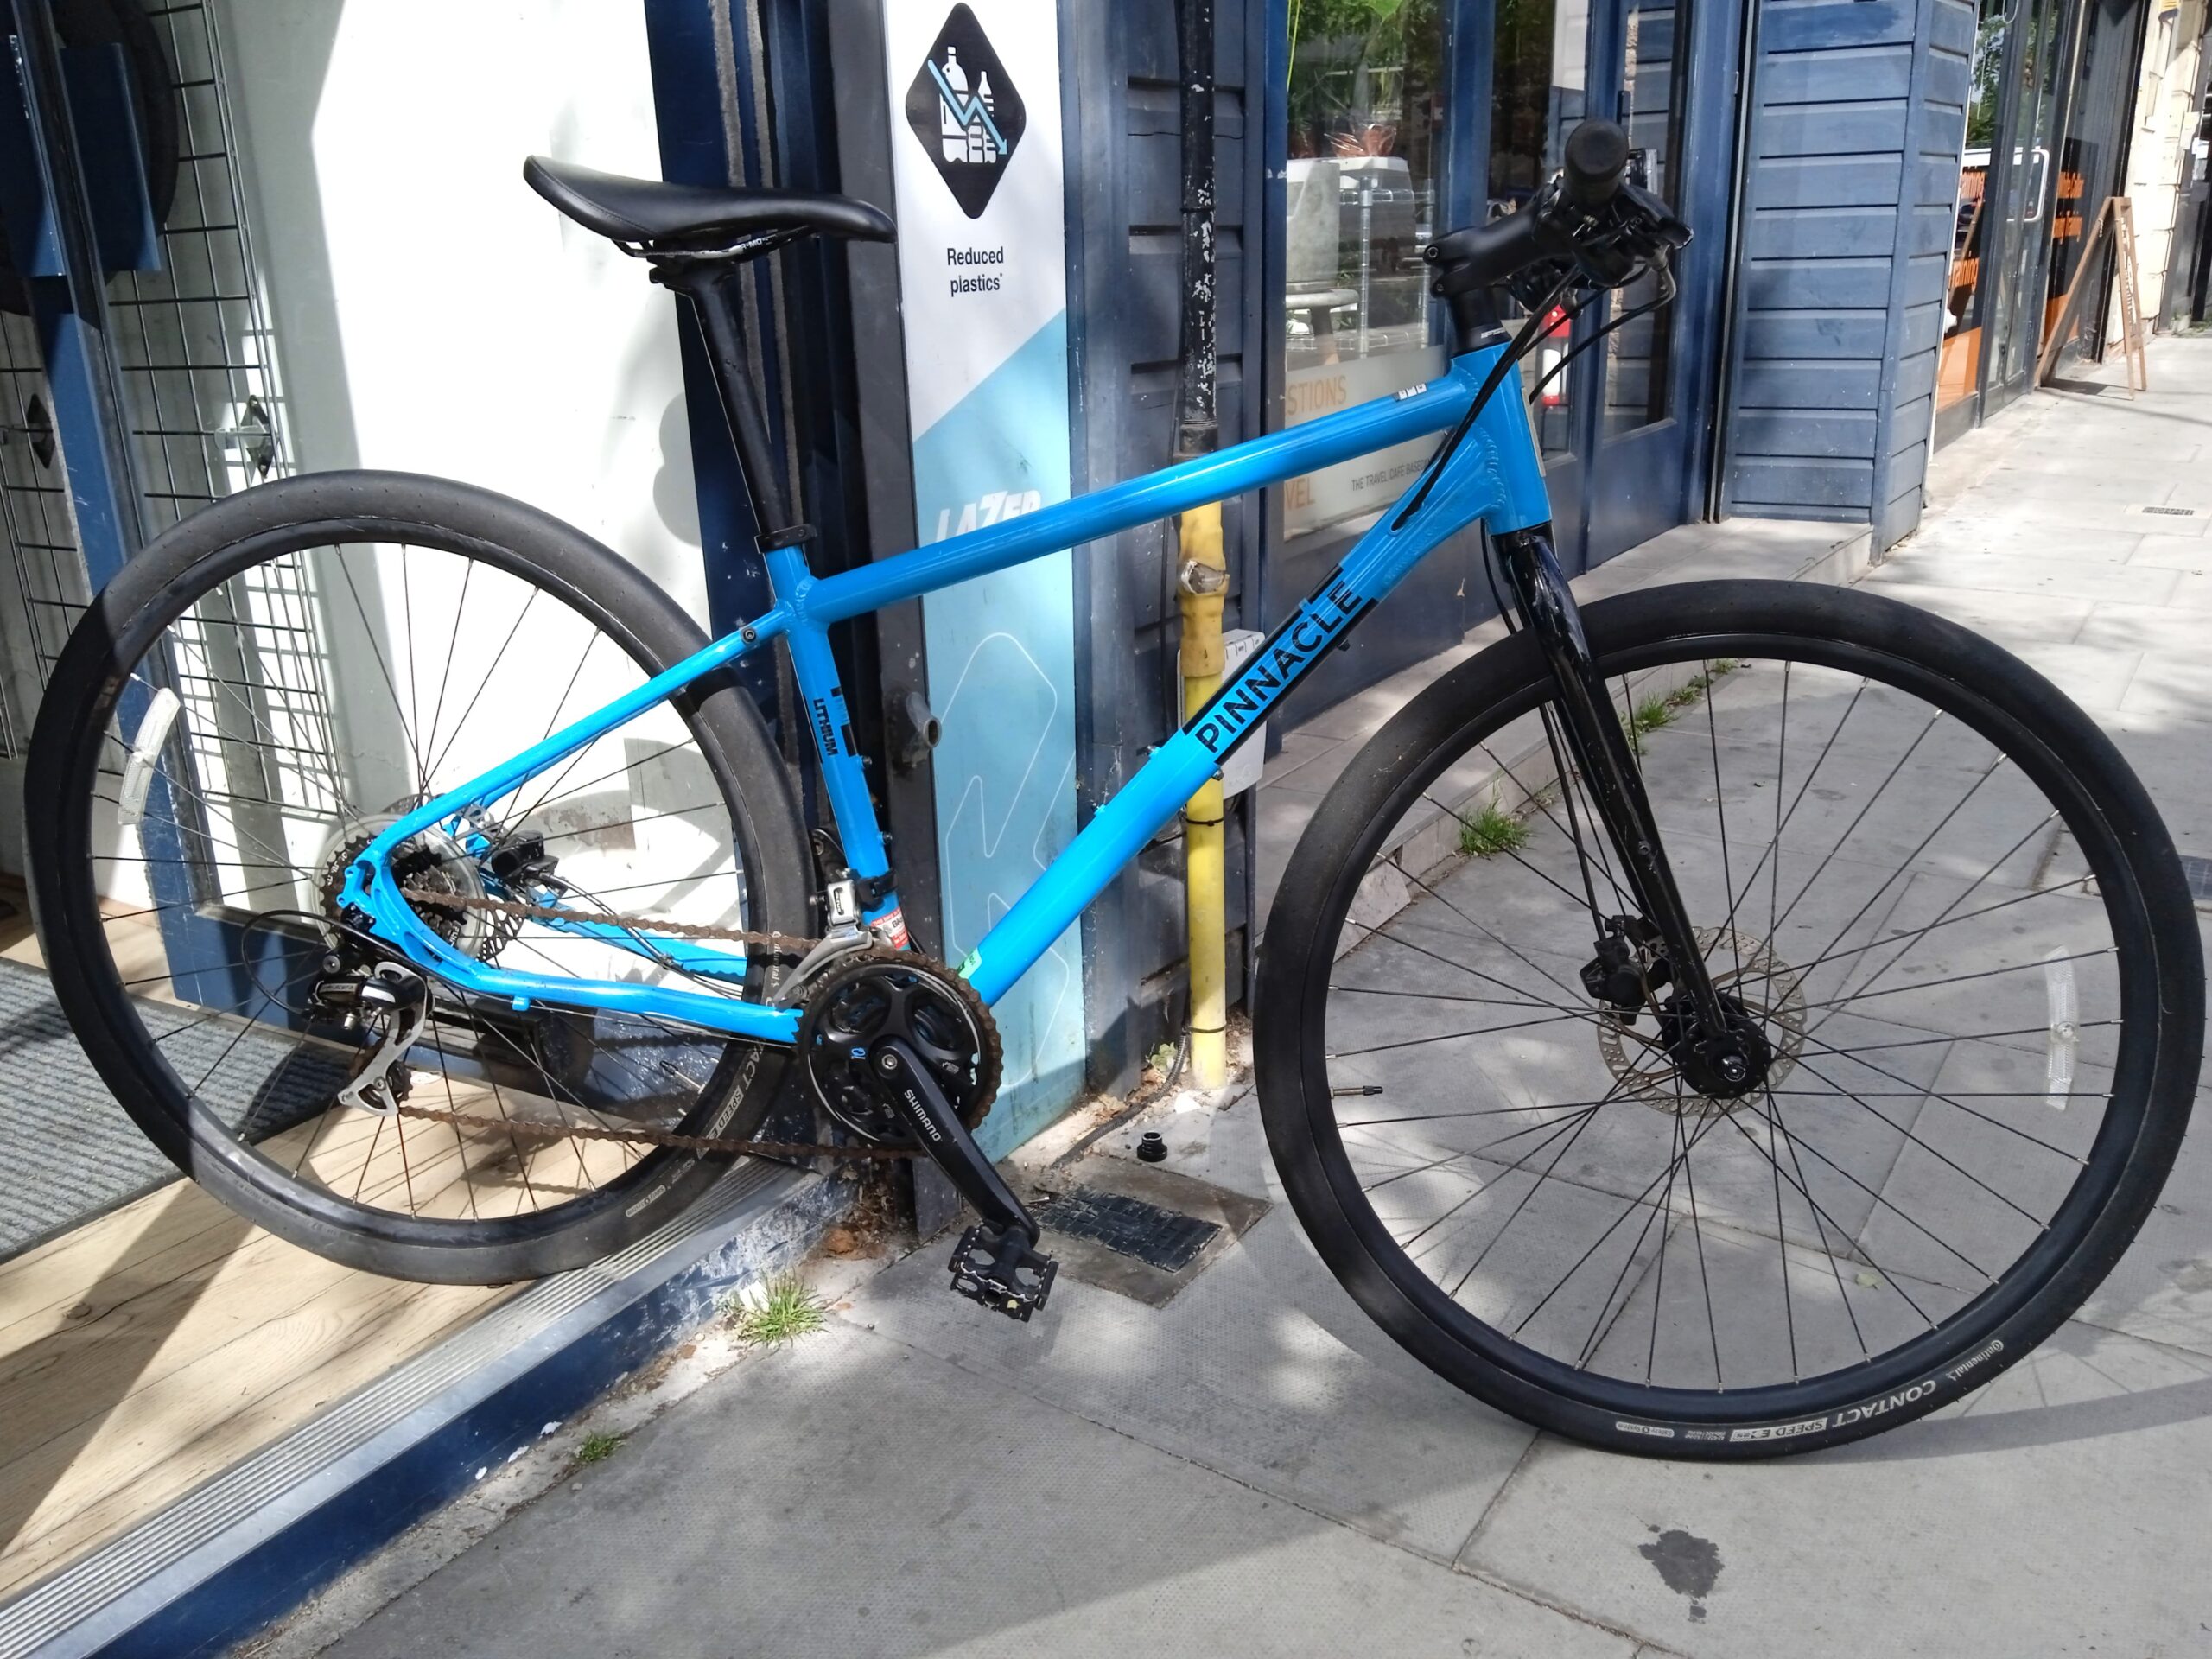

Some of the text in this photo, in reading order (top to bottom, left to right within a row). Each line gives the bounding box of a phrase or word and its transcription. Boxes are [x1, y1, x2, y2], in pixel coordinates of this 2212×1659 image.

[947, 245, 1004, 266] Reduced
[1287, 375, 1347, 416] STIONS
[1351, 477, 1364, 492] THE
[1365, 470, 1388, 488] TRAVEL
[1194, 580, 1363, 754] PINNACLE
[718, 1090, 743, 1128] SPEED
[904, 1089, 942, 1141] SHIMANO
[1954, 1339, 2004, 1377] Continental
[1832, 1380, 1936, 1428] CONTACT
[1775, 1419, 1826, 1437] SPEED
